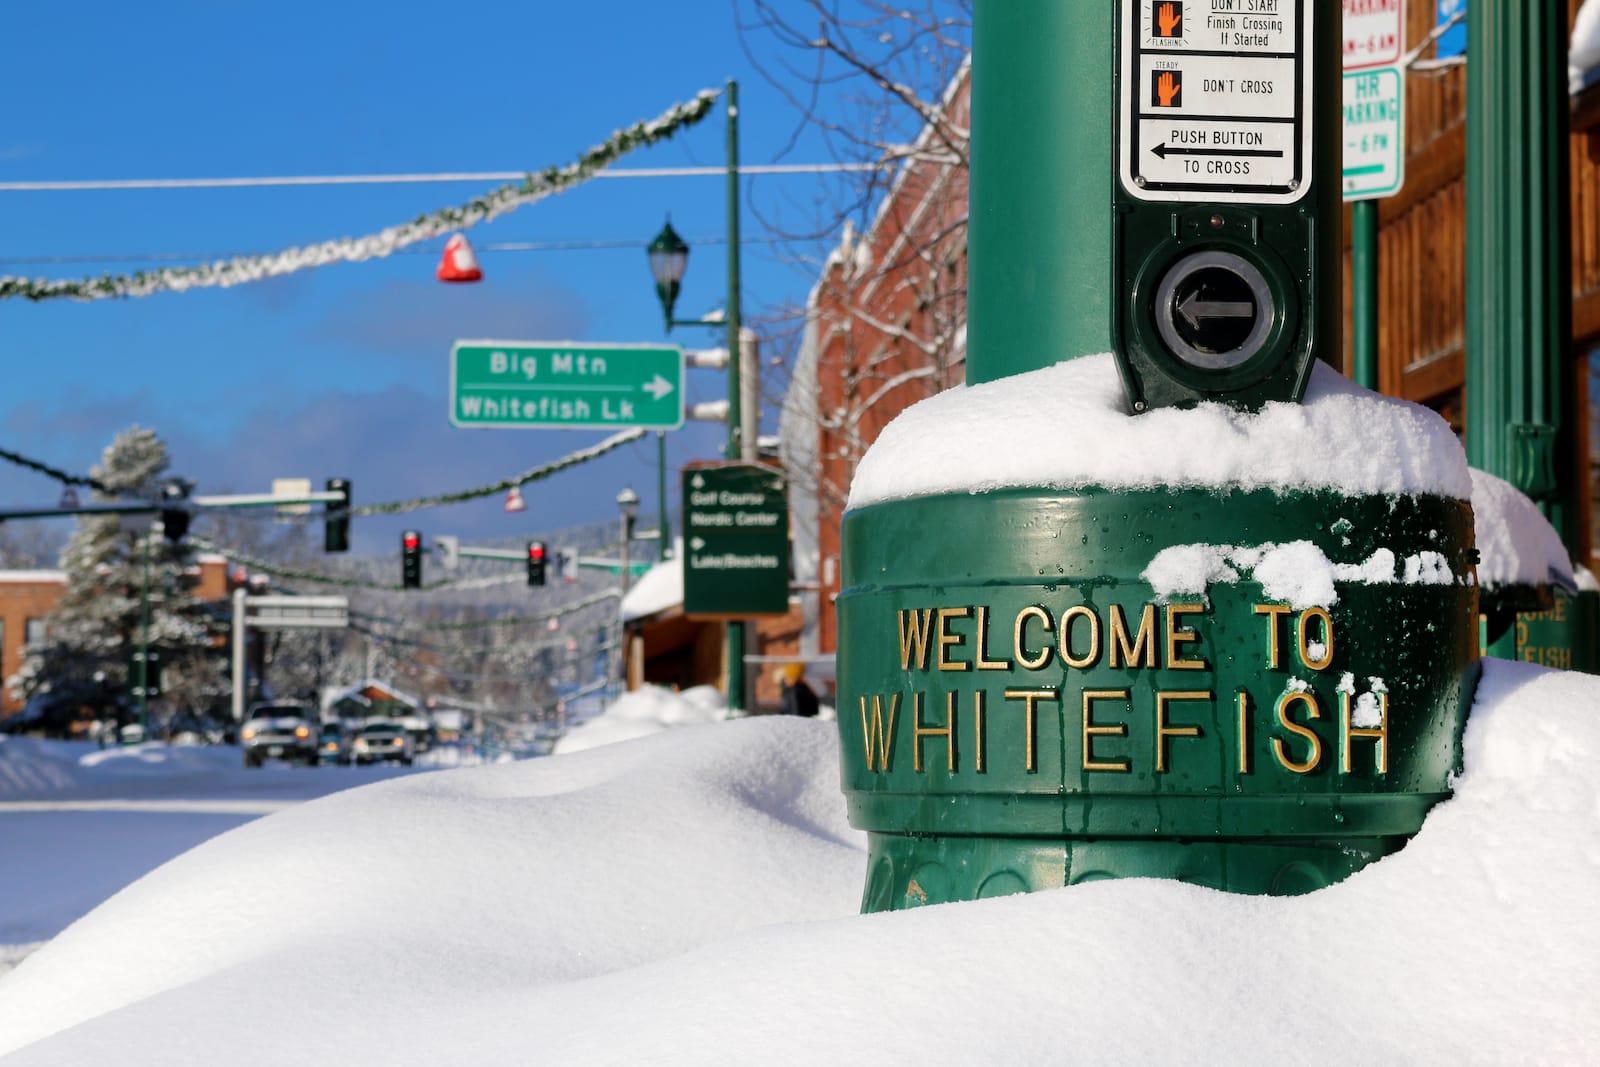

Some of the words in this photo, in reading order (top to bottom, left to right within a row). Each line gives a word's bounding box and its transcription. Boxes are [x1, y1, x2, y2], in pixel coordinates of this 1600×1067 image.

[1248, 0, 1278, 12] START
[1207, 16, 1236, 29] Finish
[1242, 17, 1283, 34] Crossing
[1152, 38, 1183, 47] FLASHING
[1220, 32, 1229, 45] If
[1234, 33, 1269, 46] Started
[1155, 61, 1179, 69] STEADY
[1203, 79, 1235, 93] DON'T
[1240, 80, 1274, 94] CROSS
[1355, 75, 1380, 99] HR
[1171, 130, 1206, 144] PUSH
[1213, 131, 1263, 145] BUTTON
[1184, 160, 1200, 173] TO
[1207, 160, 1250, 174] CROSS
[490, 352, 537, 380] Big
[552, 353, 607, 374] Mtn
[461, 396, 590, 418] Whitefish
[601, 399, 634, 419] Lk
[735, 511, 779, 526] Center
[898, 603, 1206, 671] WELCOME
[1253, 604, 1334, 671] TO
[860, 688, 1388, 774] WHITEFISH
